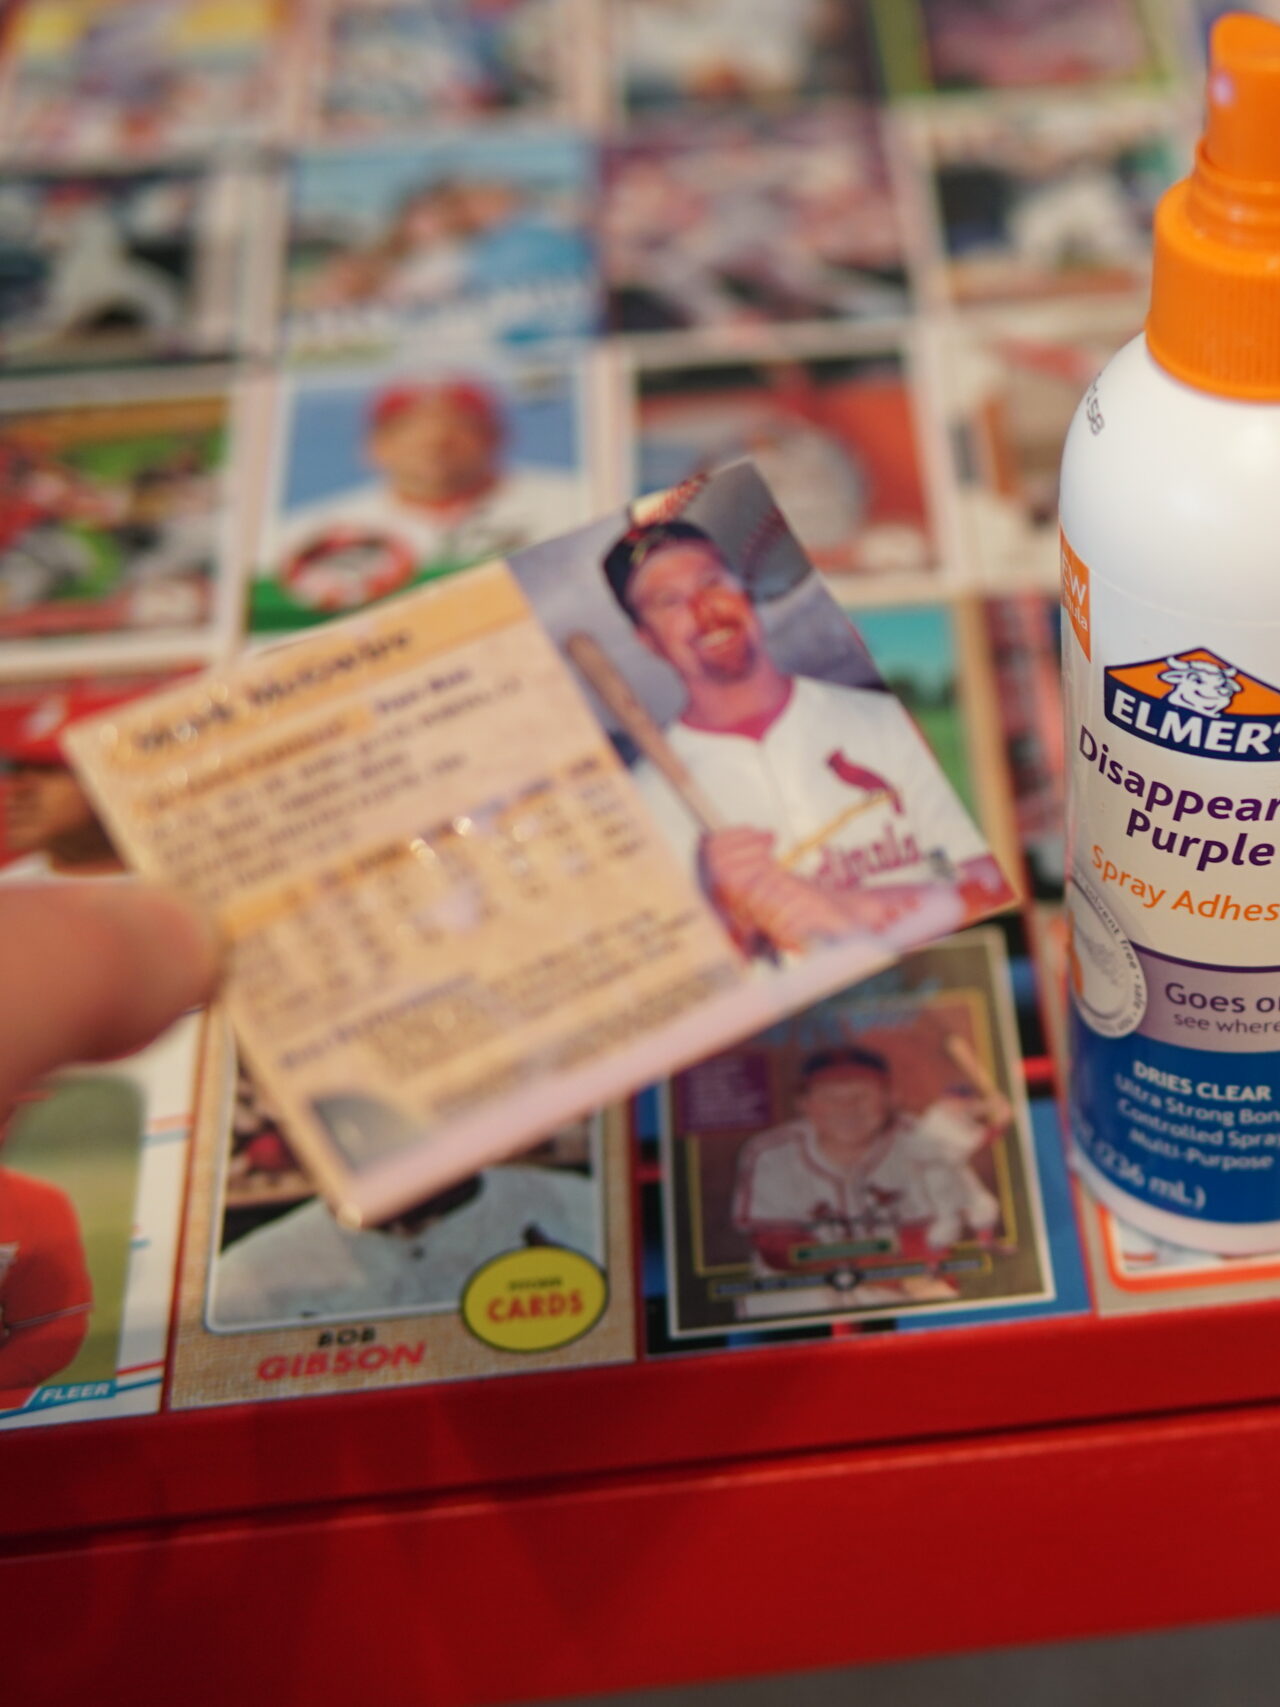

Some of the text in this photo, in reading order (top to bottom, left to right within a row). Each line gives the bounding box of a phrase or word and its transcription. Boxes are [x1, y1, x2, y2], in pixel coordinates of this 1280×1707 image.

[1126, 808, 1275, 872] Purple
[1091, 844, 1167, 909] Spray
[1165, 982, 1246, 1014] Goes
[1173, 1013, 1211, 1031] see
[1114, 1073, 1163, 1109] Ultra
[1165, 1096, 1236, 1128] Strong
[1133, 1060, 1272, 1102] DRIES CLEAR
[1117, 1098, 1224, 1146] Controlled
[1128, 1127, 1274, 1172] Multi-Purpose
[487, 1289, 585, 1325] CARDS
[317, 1325, 377, 1348] BOB
[256, 1340, 427, 1382] GIBSON
[41, 1381, 112, 1403] FLEER
